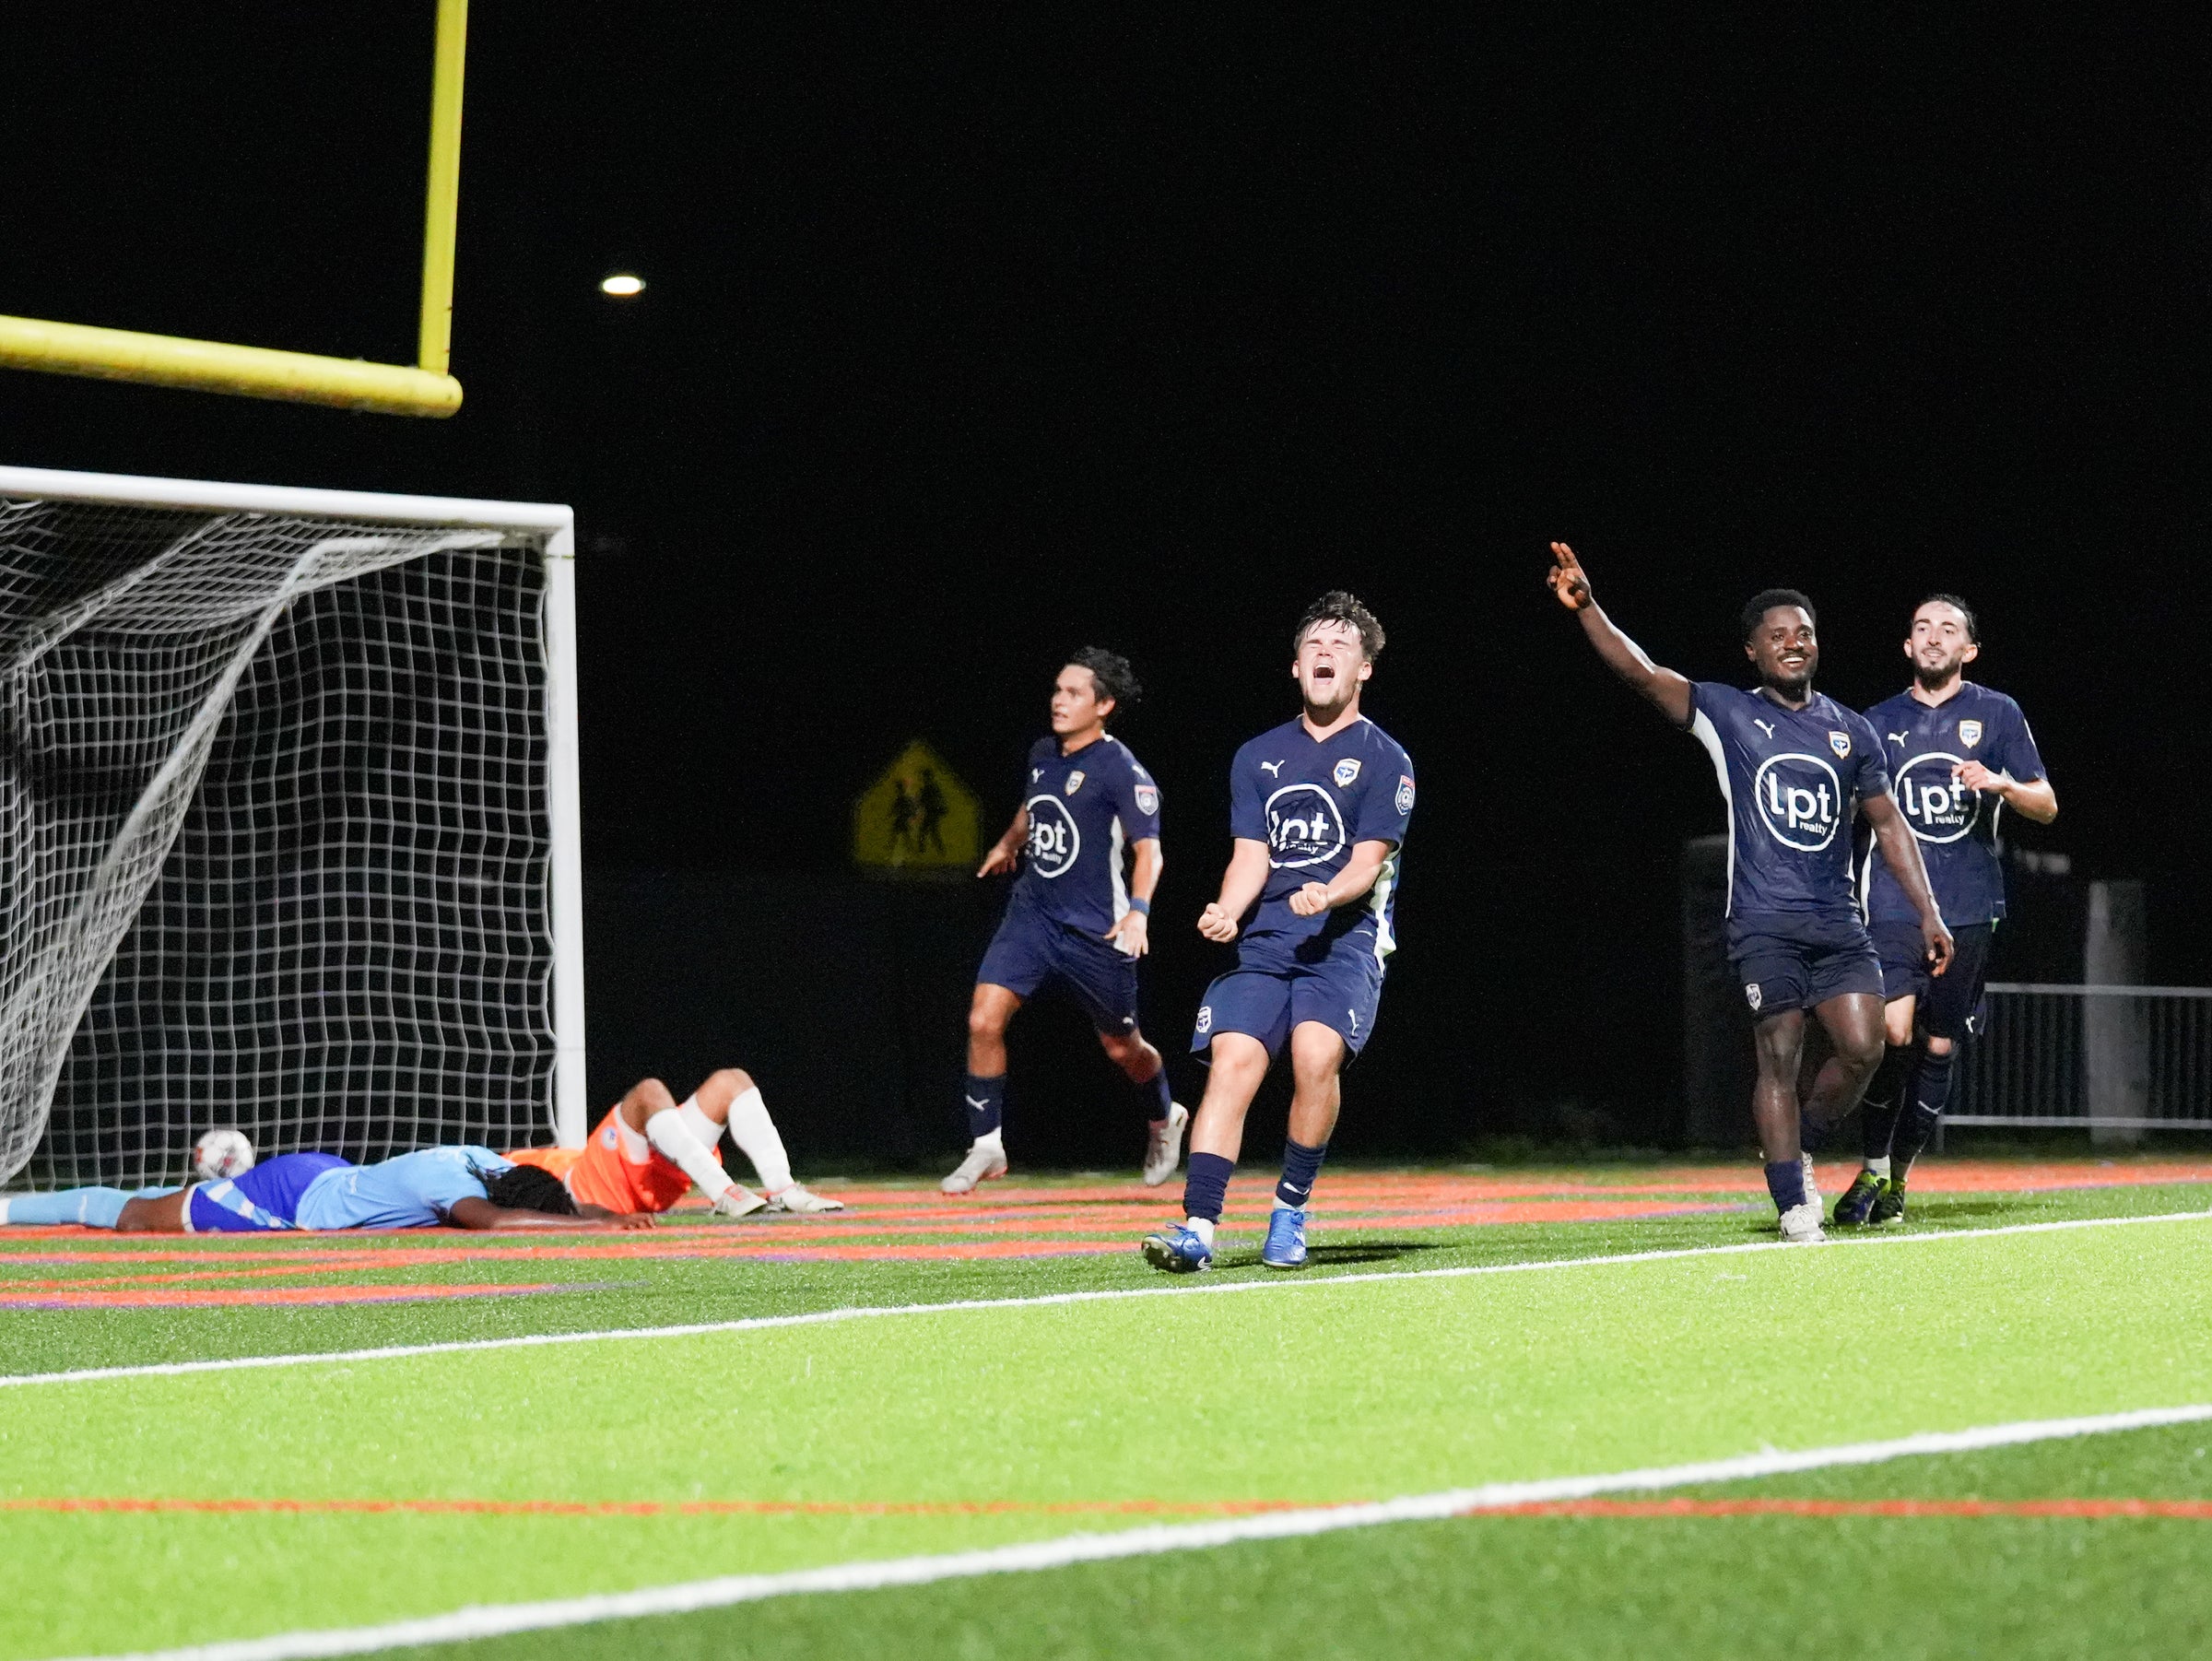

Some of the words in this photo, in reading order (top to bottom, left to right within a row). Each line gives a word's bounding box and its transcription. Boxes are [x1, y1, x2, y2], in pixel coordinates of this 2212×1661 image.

[1769, 772, 1832, 828] lpt
[1903, 777, 1969, 825] lpt
[1800, 821, 1828, 836] realty
